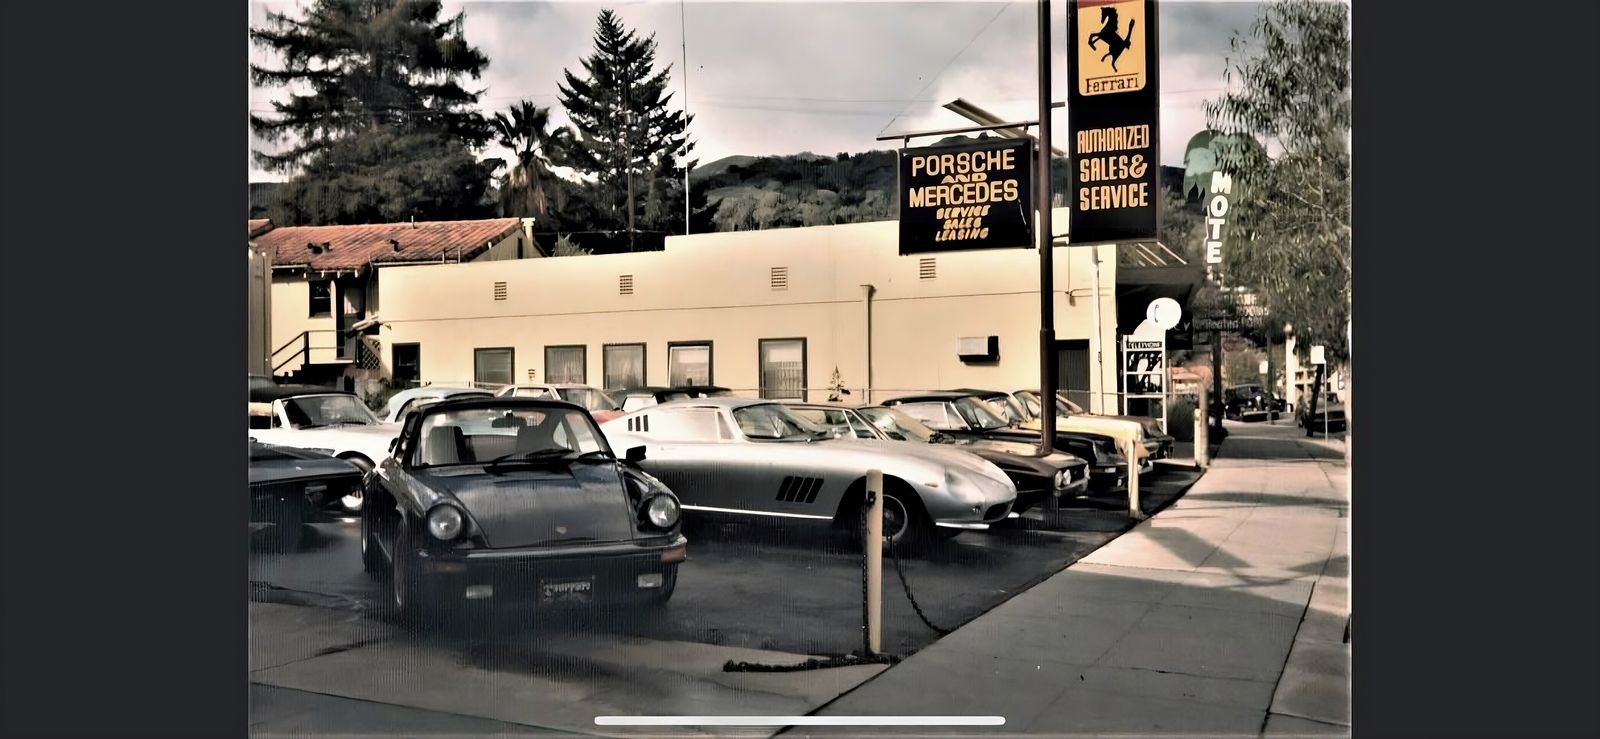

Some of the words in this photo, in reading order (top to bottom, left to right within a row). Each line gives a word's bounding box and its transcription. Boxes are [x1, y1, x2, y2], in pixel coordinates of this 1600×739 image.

[1085, 77, 1139, 93] Ferrari
[1077, 124, 1149, 154] AUTHORIZED
[912, 149, 1015, 177] PORSCHE
[941, 172, 987, 184] AND
[909, 179, 1018, 208] MERCEDES
[1079, 182, 1148, 211] SERVICE
[936, 205, 991, 219] SERVICE
[943, 217, 981, 229] SALES
[935, 227, 989, 242] LEASING
[1206, 171, 1232, 279] MOTE
